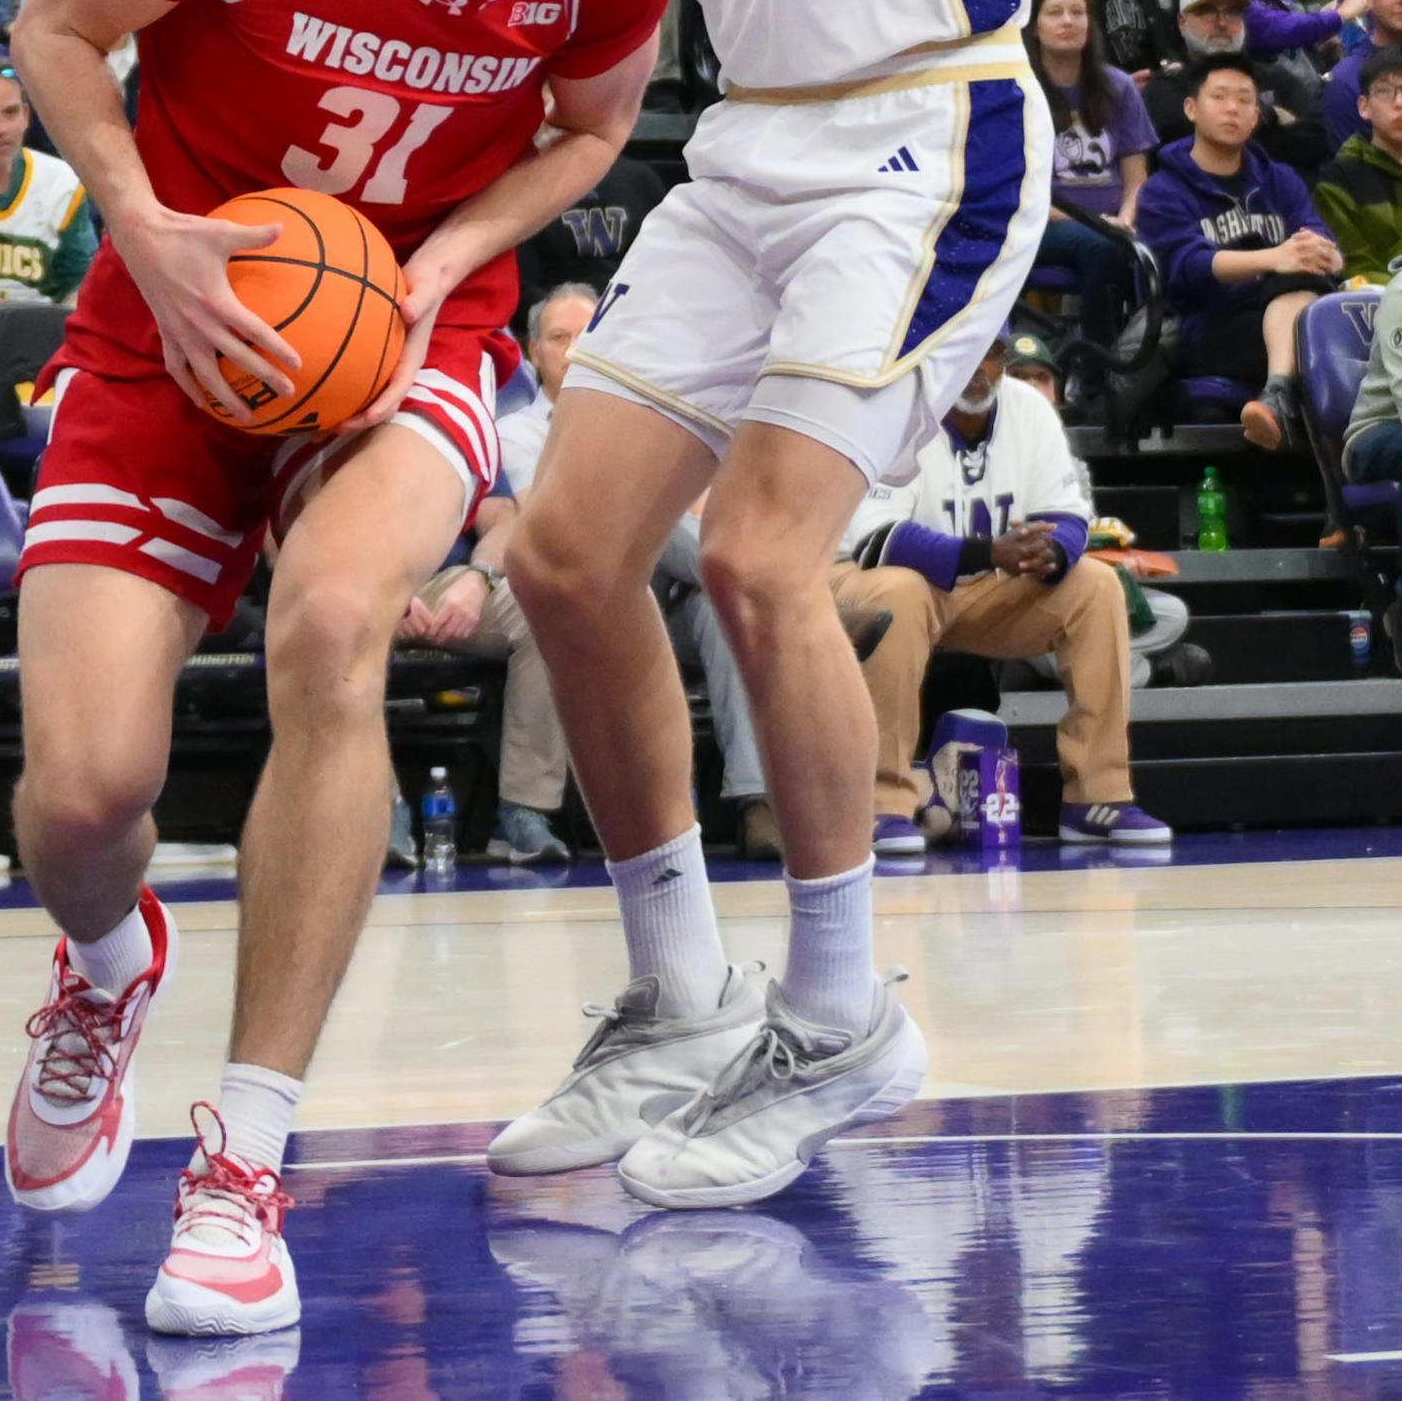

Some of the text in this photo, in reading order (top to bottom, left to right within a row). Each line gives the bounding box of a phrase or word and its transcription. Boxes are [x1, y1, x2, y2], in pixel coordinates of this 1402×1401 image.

[286, 11, 543, 94] WISCONSIN
[281, 85, 453, 204] 31
[561, 205, 628, 258] W
[985, 792, 1017, 824] 22
